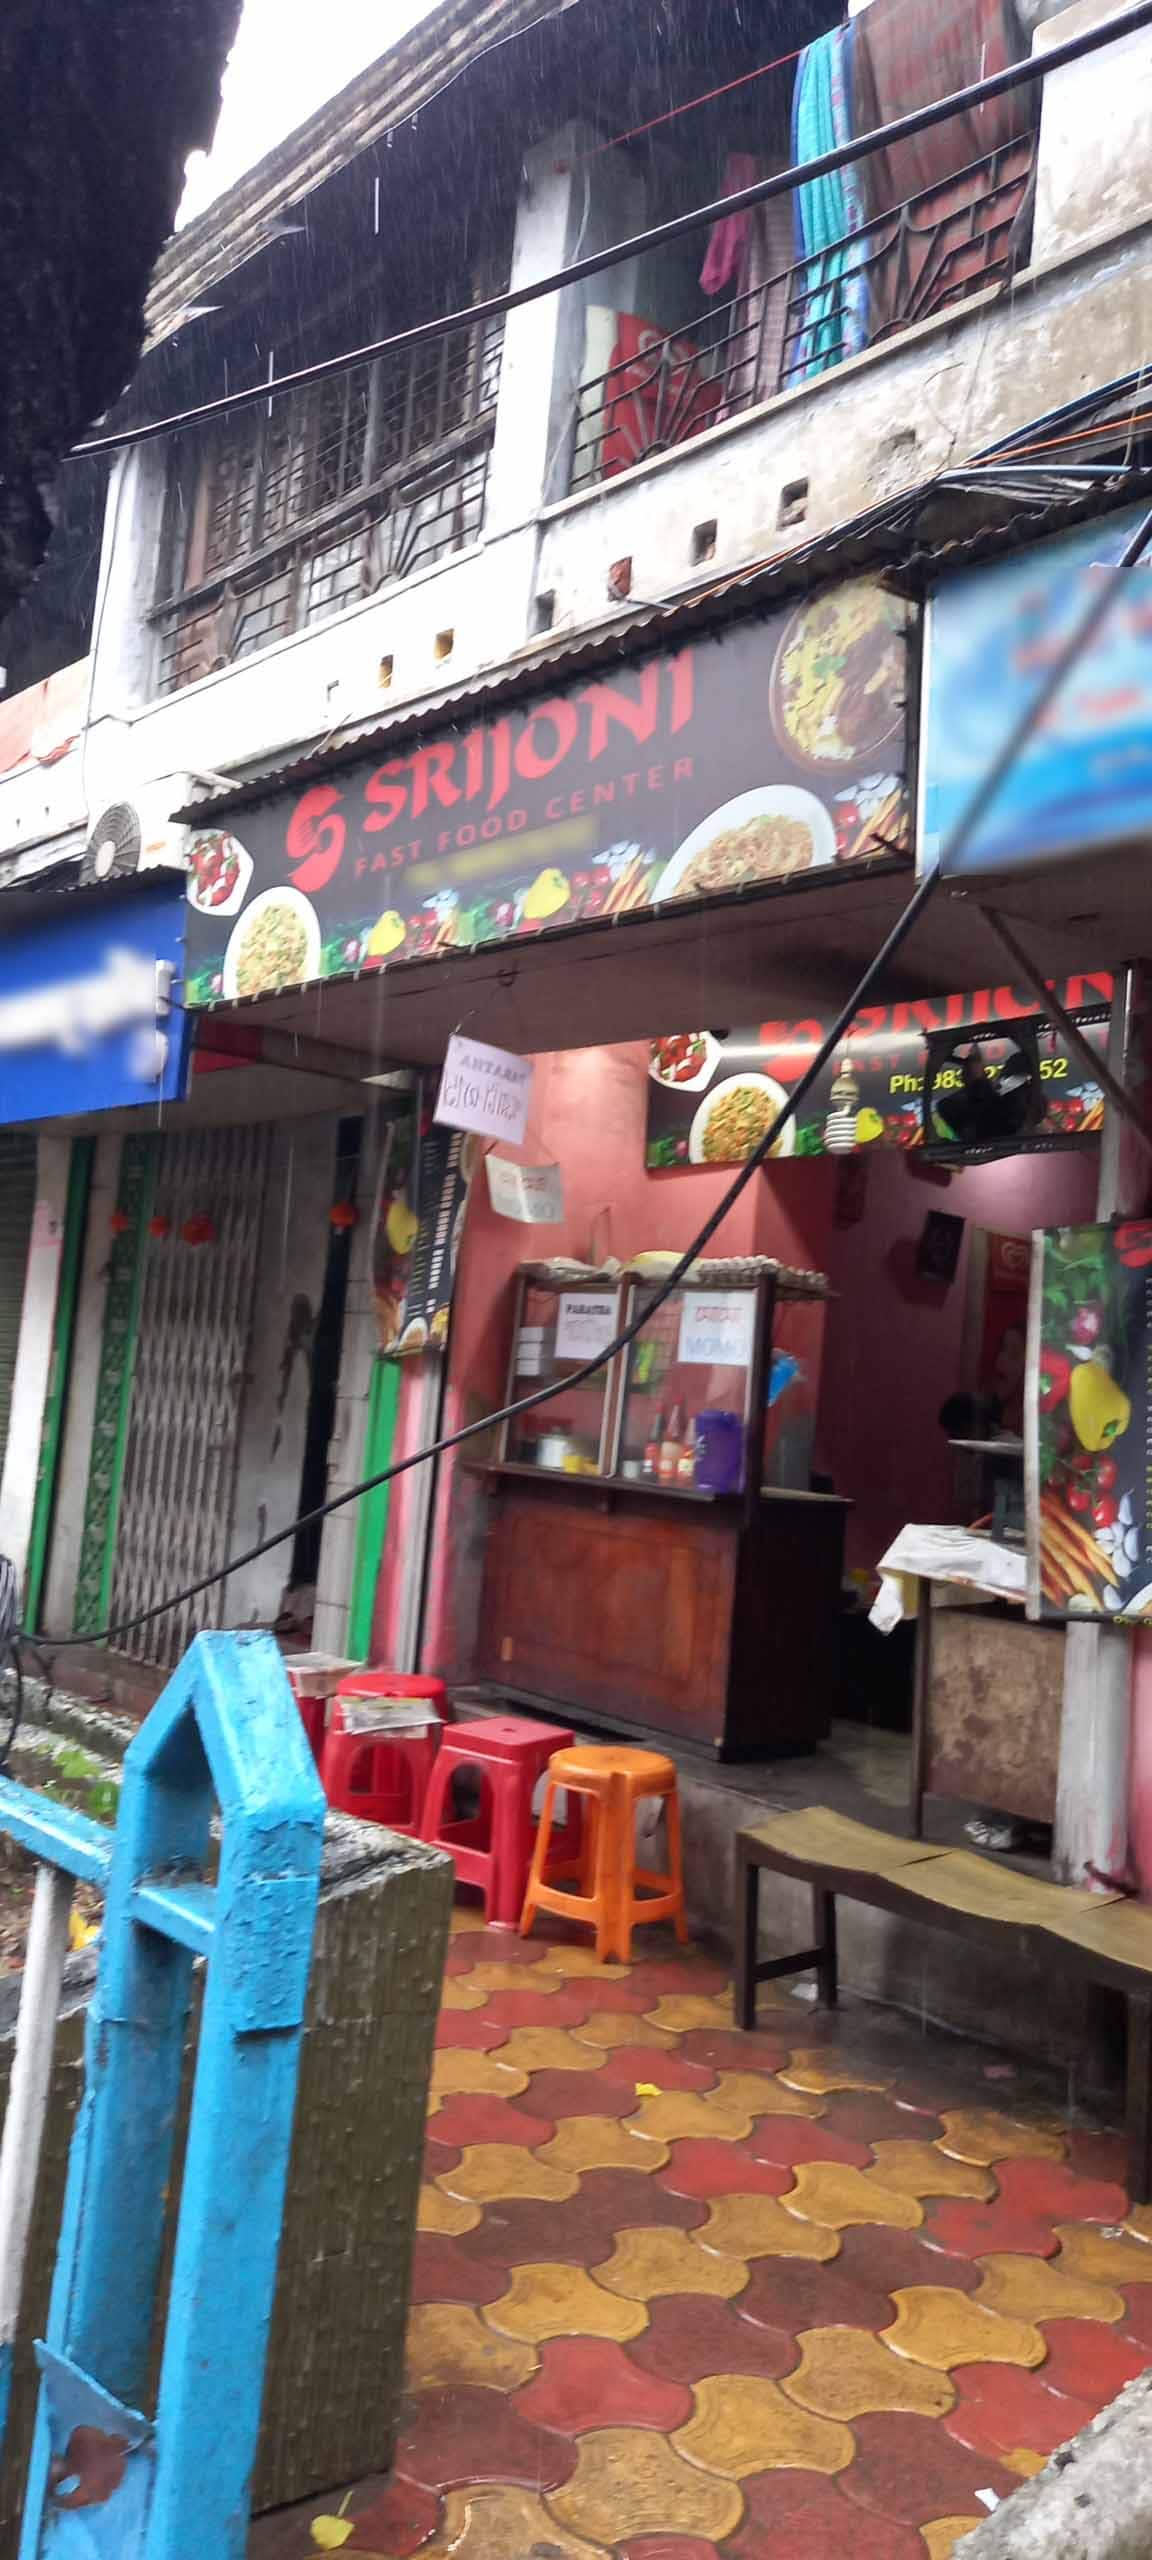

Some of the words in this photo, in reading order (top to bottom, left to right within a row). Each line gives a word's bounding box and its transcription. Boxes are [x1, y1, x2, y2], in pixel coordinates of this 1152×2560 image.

[362, 648, 694, 832] SRIJONI
[354, 839, 421, 878] FAST
[437, 808, 528, 850] FOOD
[545, 756, 694, 820] CENTER
